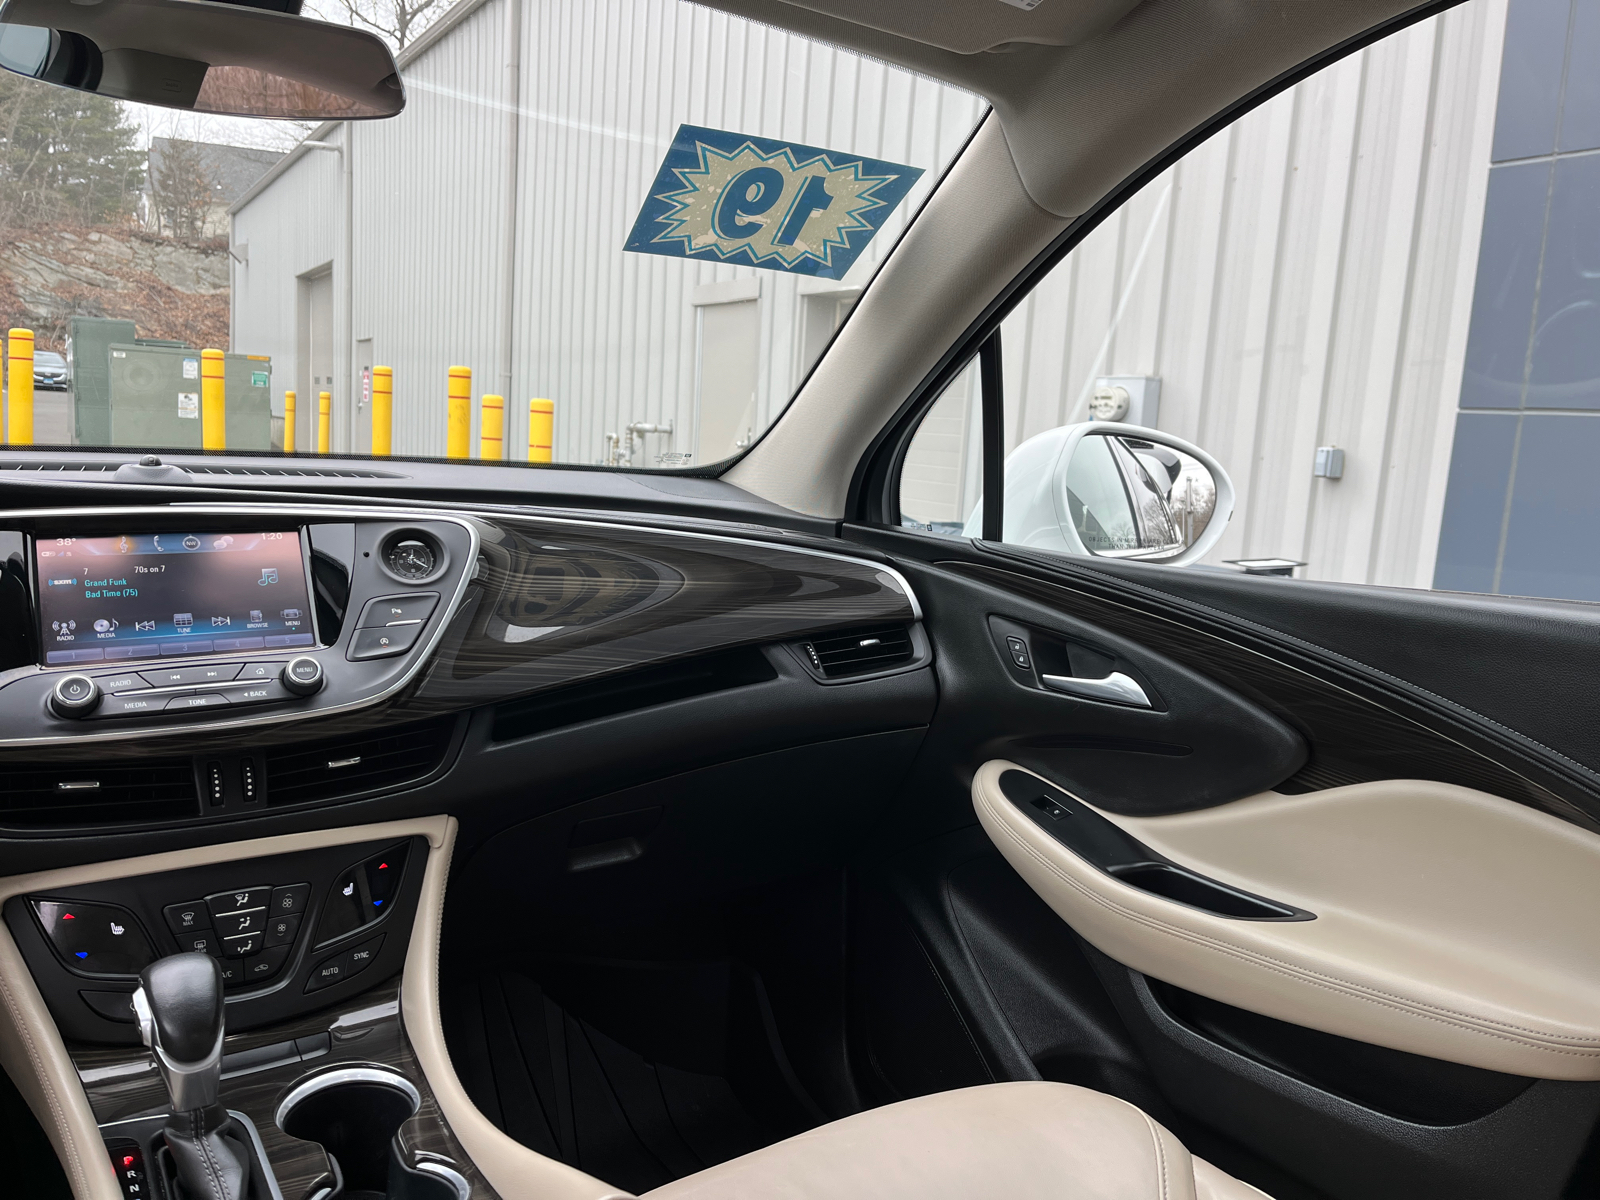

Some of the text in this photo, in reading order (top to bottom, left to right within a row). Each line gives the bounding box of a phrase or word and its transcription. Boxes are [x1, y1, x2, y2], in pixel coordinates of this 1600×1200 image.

[261, 532, 283, 540] 1:20
[83, 567, 88, 575] 7
[134, 566, 148, 574] 70s
[160, 565, 166, 573] 7
[84, 579, 107, 587] Grand
[85, 590, 101, 598] Bad
[123, 589, 138, 597] (75)
[110, 679, 132, 688] RADIO
[250, 690, 268, 698] BACK
[124, 702, 147, 710] MEDIA
[188, 698, 207, 706] TONE
[353, 950, 370, 960] SYNC
[322, 966, 339, 977] AUTO
[123, 1155, 134, 1165] P
[126, 1169, 137, 1178] R
[129, 1184, 140, 1193] N
